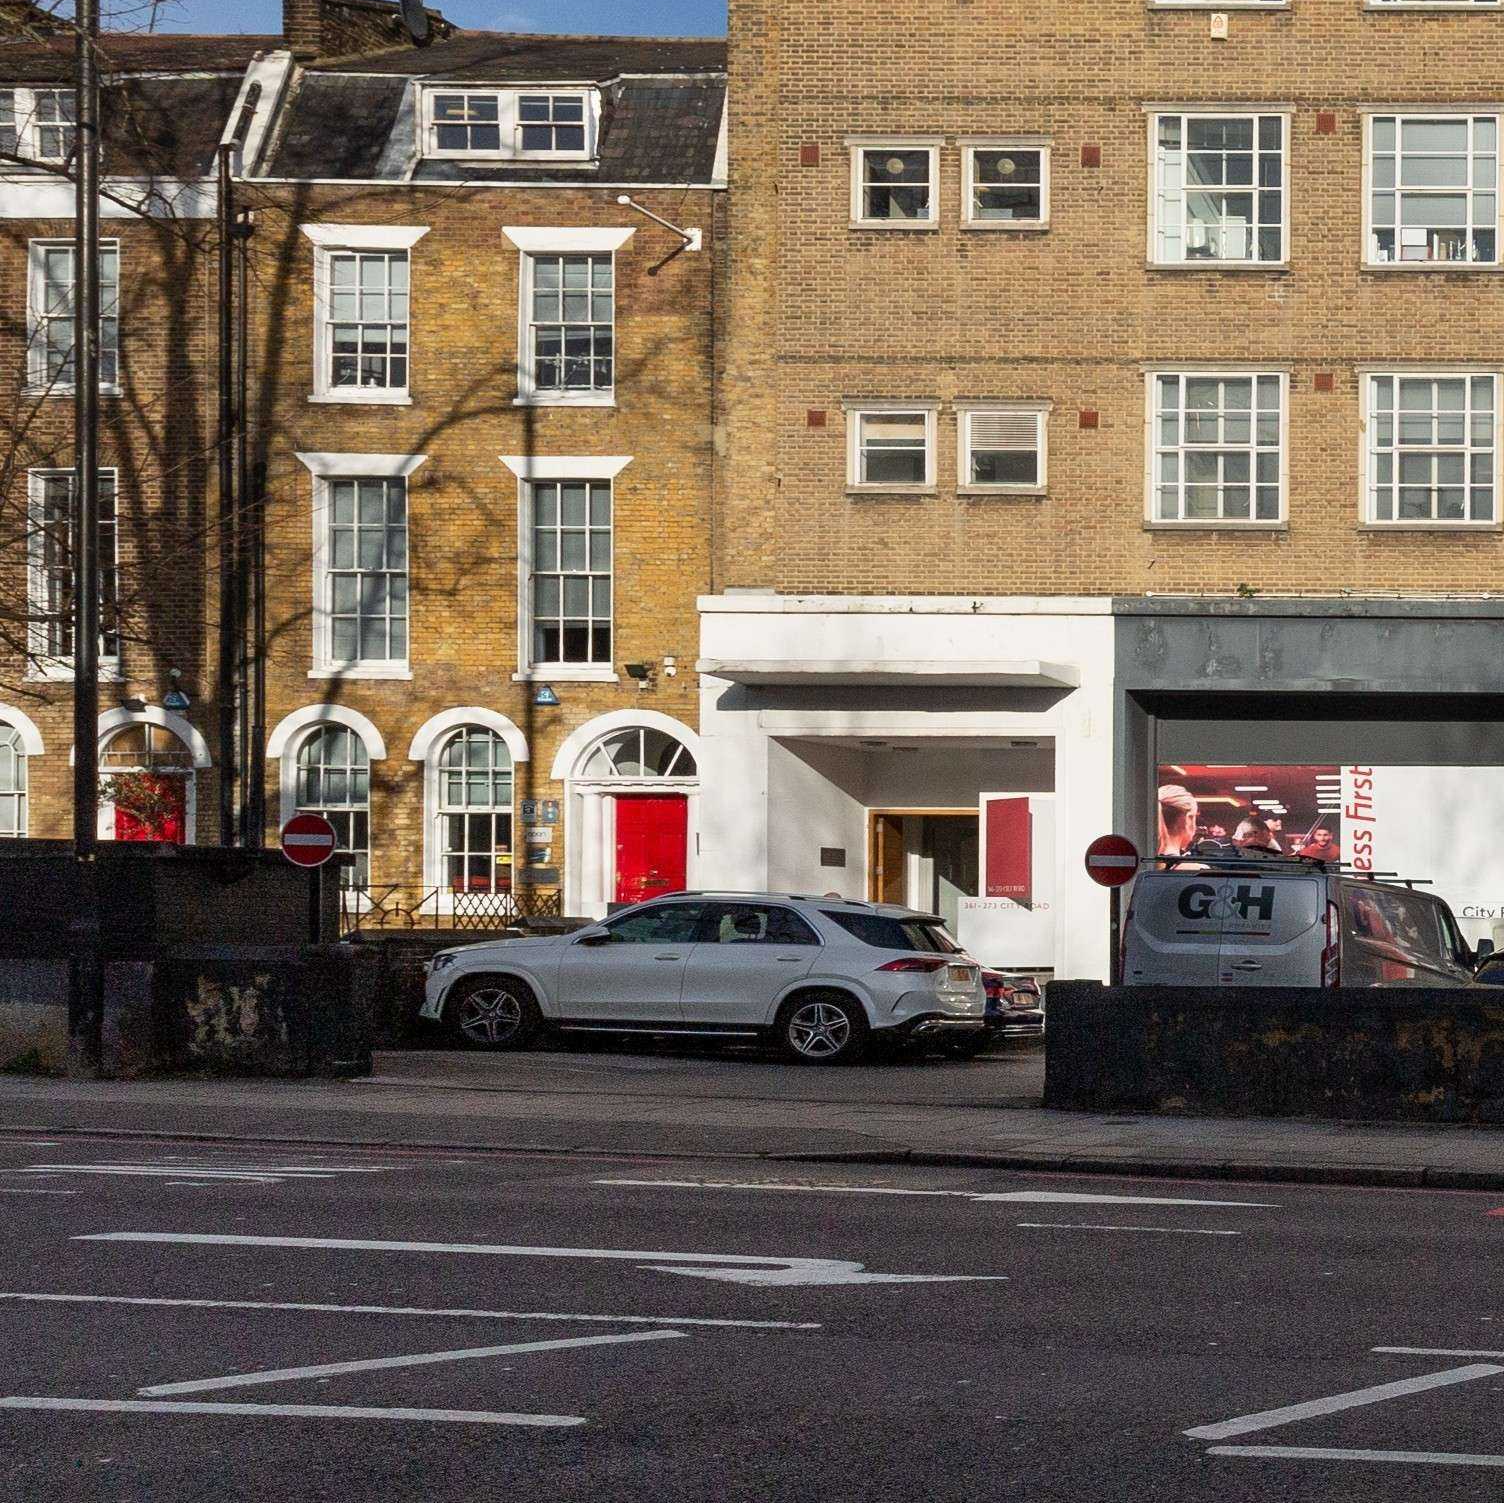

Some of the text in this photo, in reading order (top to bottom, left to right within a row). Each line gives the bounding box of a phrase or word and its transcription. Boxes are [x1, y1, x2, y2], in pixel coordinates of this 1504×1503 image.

[1345, 764, 1377, 823] First
[1178, 883, 1275, 920] G&H
[1462, 906, 1495, 919] City
